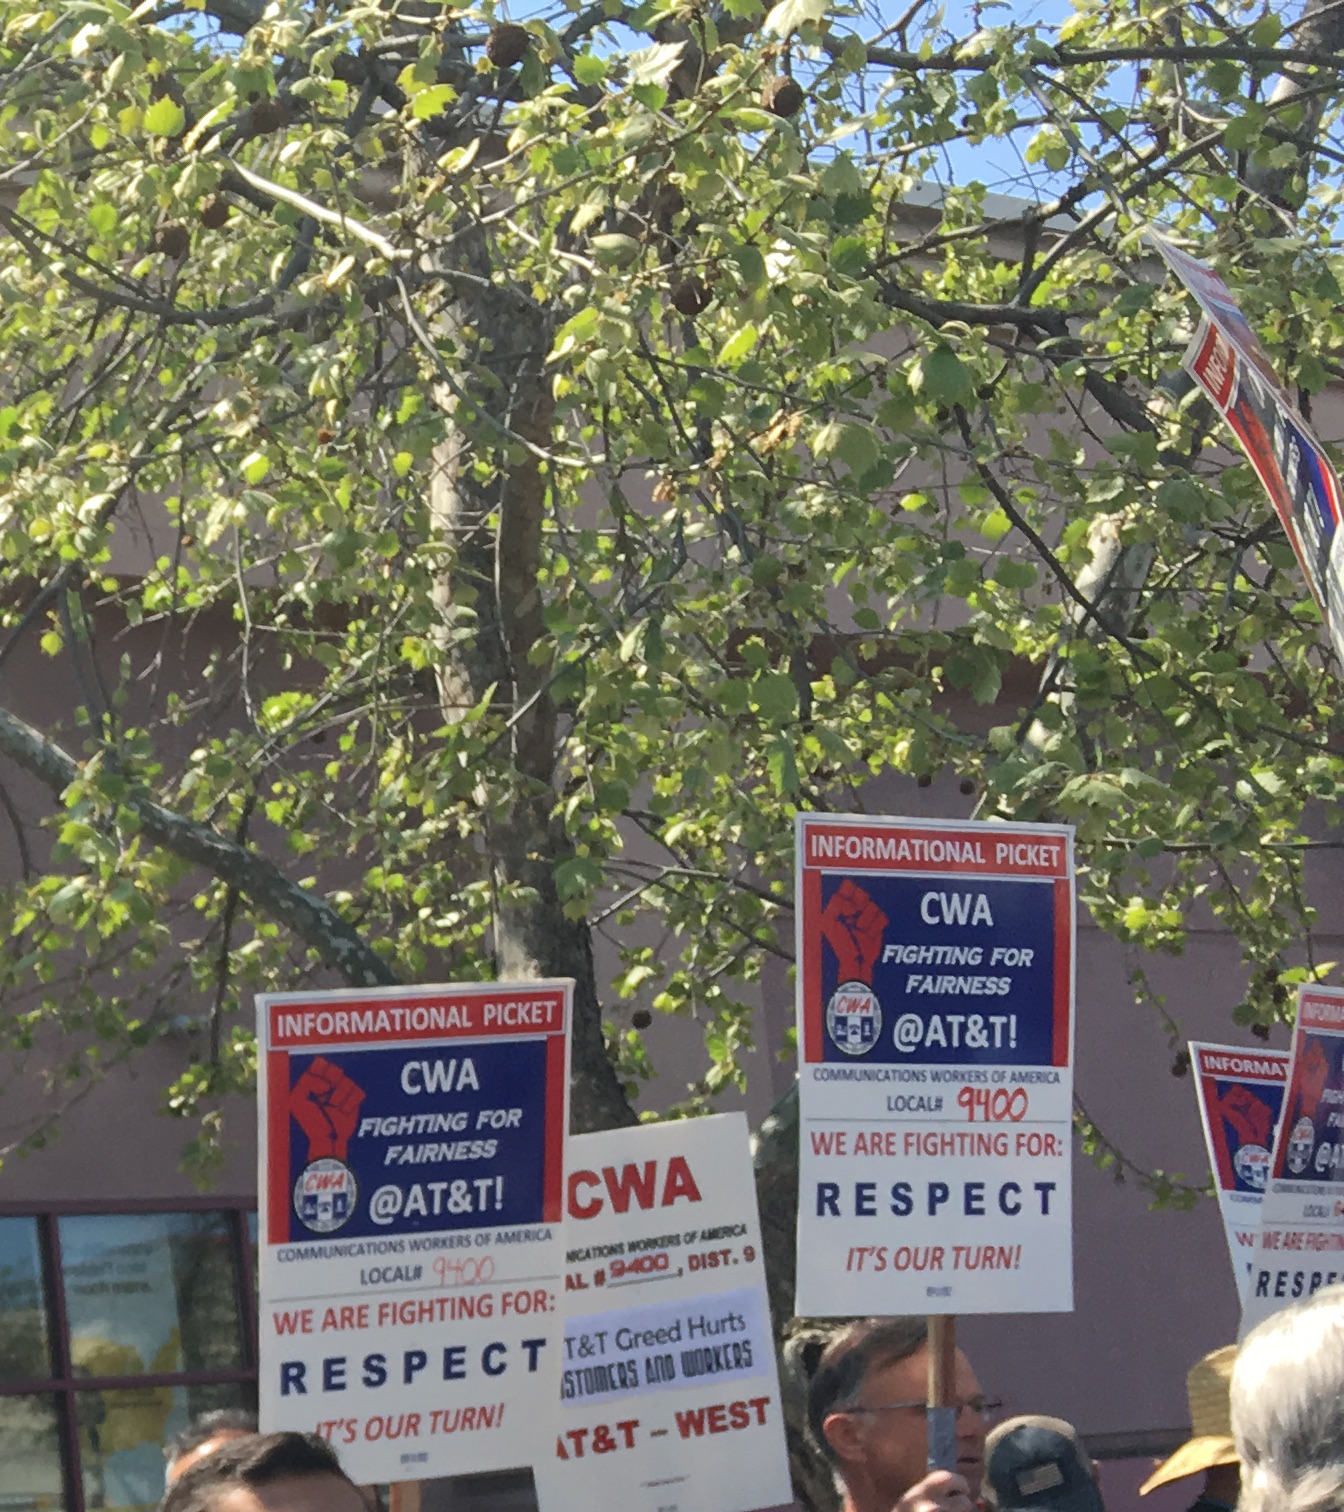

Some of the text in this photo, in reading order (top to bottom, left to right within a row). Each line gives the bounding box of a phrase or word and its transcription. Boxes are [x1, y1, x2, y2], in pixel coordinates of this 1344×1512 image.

[811, 835, 1060, 867] INFORMATIONAL PICKET
[920, 891, 994, 927] CWA
[882, 945, 1035, 968] FIGHTING FOR
[905, 974, 1011, 996] FAIRNESS
[277, 1001, 557, 1037] INFORMATIONAL PICKET
[835, 995, 871, 1014] CWA
[893, 1013, 1017, 1053] @AT&T!
[400, 1057, 480, 1095] CWA
[813, 1067, 1060, 1085] COMMUNICATIONS WORKERS OF AMERICA
[957, 1086, 1028, 1122] 9400
[357, 1108, 522, 1138] FIGHTING FOR
[384, 1139, 498, 1166] FAIRNESS
[810, 1131, 1063, 1157] WE ARE FIGHTING FOR:
[304, 1170, 346, 1192] CWA
[567, 1155, 702, 1220] CWA
[816, 1181, 1057, 1217] RESPECT
[369, 1176, 504, 1226] @AT&T!
[277, 1227, 553, 1263] COMMUNICATIONS WORKERS OF AMERICA
[627, 1233, 681, 1253] WORKERS
[683, 1230, 698, 1244] OF
[700, 1223, 747, 1242] AMERICA
[432, 1255, 496, 1288] 9400
[688, 1249, 739, 1271] DIST.
[743, 1245, 756, 1263] 9
[846, 1244, 1022, 1272] IT'S OUR TURN!
[273, 1289, 555, 1336] WE ARE FIGHTING FOR:
[615, 1318, 682, 1352] Greed
[687, 1311, 746, 1341] Hurts
[280, 1338, 547, 1396] RESPECT
[645, 1354, 676, 1384] AND
[680, 1339, 754, 1378] WORKERS
[364, 1413, 420, 1443] OUR
[429, 1402, 505, 1435] TURN!
[675, 1396, 771, 1440] WEST
